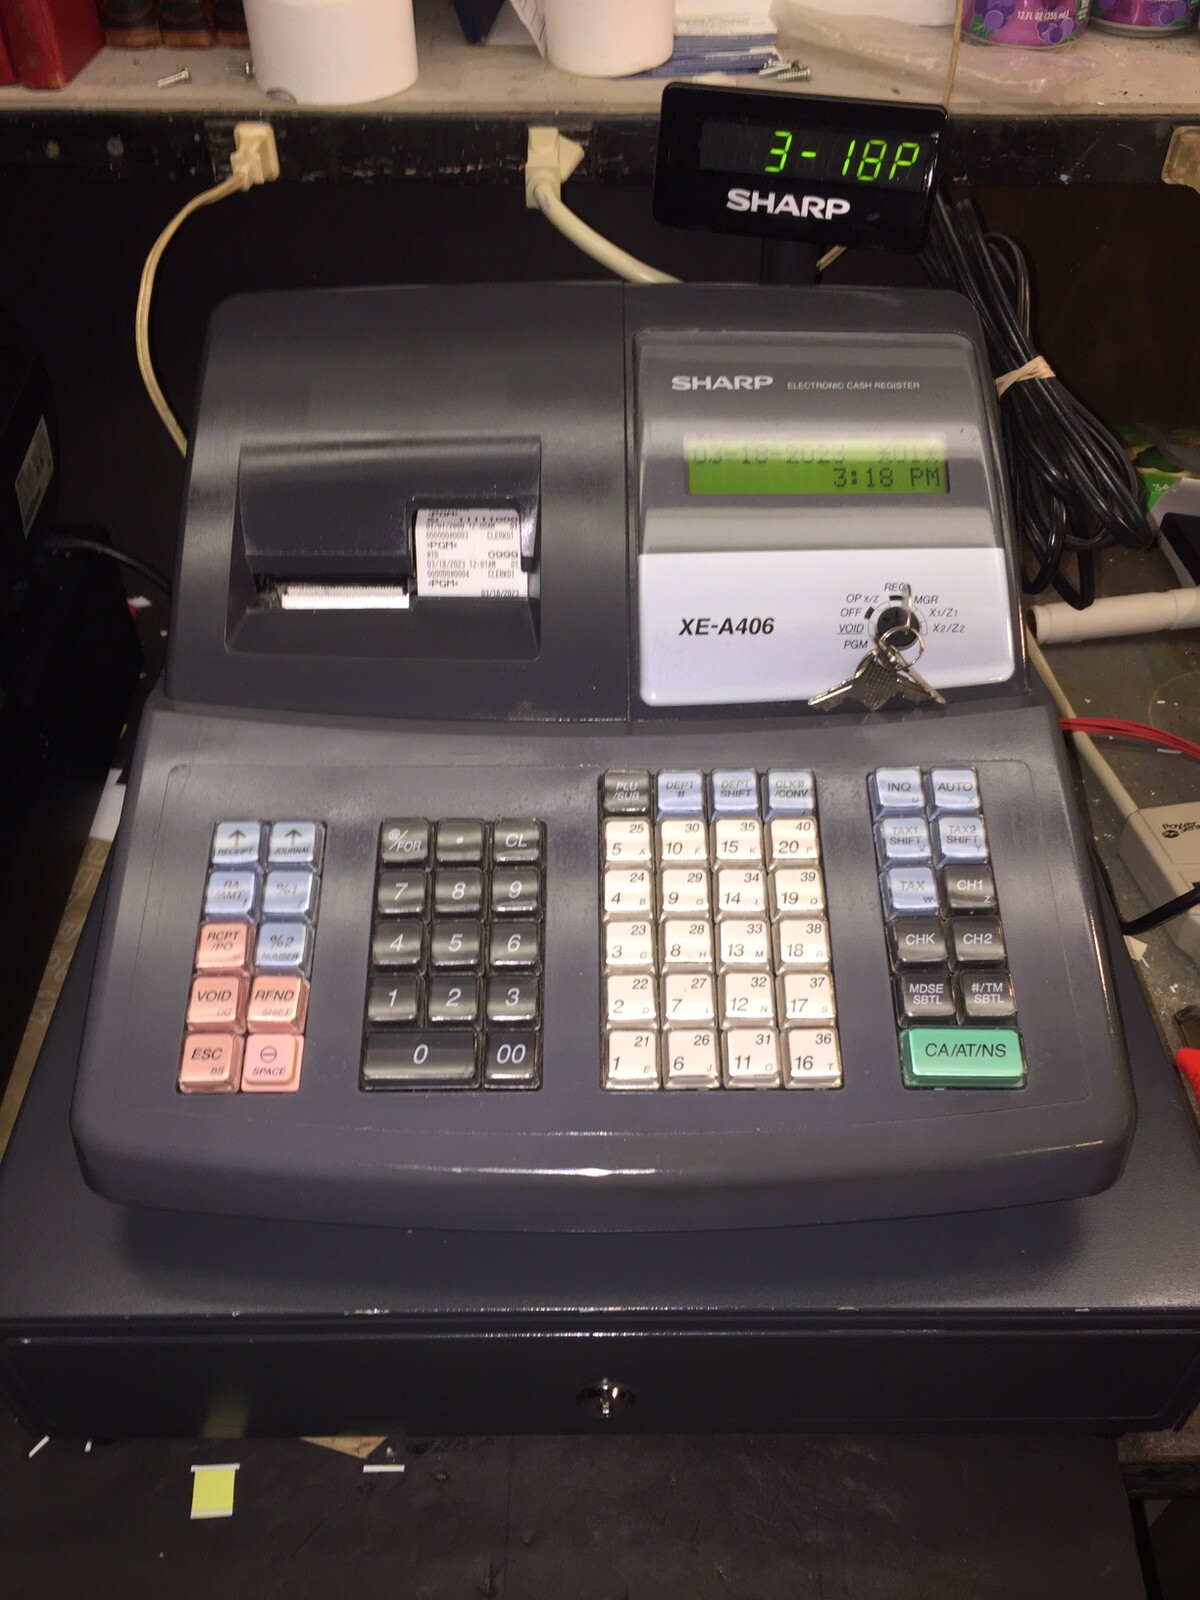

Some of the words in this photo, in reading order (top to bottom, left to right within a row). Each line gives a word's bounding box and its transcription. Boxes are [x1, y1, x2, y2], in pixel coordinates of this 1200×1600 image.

[726, 186, 851, 221] SHARP
[671, 375, 774, 392] SHARP
[787, 381, 844, 390] ELECTRONIC
[846, 381, 872, 390] CASH
[874, 381, 920, 390] REGISTER
[833, 467, 894, 488] 3:18
[910, 467, 941, 487] PM
[846, 593, 862, 604] OP
[864, 595, 880, 604] X/Z
[913, 595, 939, 605] MGR
[840, 608, 863, 618] OFF
[929, 608, 959, 618] X1/Z1
[678, 617, 775, 636] XE-A406
[838, 623, 865, 634] VOID
[932, 623, 966, 633] X2/Z2
[843, 640, 869, 650] PGM
[615, 782, 638, 790] PLU
[665, 781, 694, 790] DEPT
[720, 780, 749, 789] DEPT
[887, 782, 911, 793] INQ
[937, 782, 973, 792] AUTO
[720, 789, 752, 798] SHIFT
[774, 789, 809, 798] /CONV
[629, 823, 644, 834] 25
[685, 823, 700, 833] 30
[740, 822, 755, 832] 35
[795, 822, 811, 832] 40
[891, 826, 918, 834] TAX1
[948, 825, 977, 834] TAX2
[504, 833, 528, 848] CL
[889, 836, 922, 845] SHIFT
[946, 835, 979, 844] SHIFT
[272, 847, 311, 855] JOURNAL
[611, 842, 622, 855] 5
[665, 842, 683, 855] 10
[721, 841, 739, 854] 15
[777, 841, 800, 854] 20
[629, 873, 645, 883] 24
[687, 873, 703, 883] 29
[744, 873, 760, 883] 34
[800, 872, 816, 882] 39
[508, 880, 522, 898] 9
[900, 880, 925, 891] TAX
[956, 879, 984, 890] CH1
[394, 882, 409, 900] 7
[451, 881, 466, 900] 8
[611, 892, 622, 904] 4
[668, 892, 679, 904] 9
[724, 892, 742, 904] 14
[781, 892, 799, 904] 19
[631, 924, 646, 935] 23
[689, 924, 705, 935] 28
[746, 923, 763, 934] 33
[806, 923, 822, 934] 38
[389, 933, 404, 952] 4
[448, 933, 463, 952] 5
[507, 933, 521, 952] 6
[905, 933, 935, 945] CHK
[962, 933, 992, 944] CH2
[611, 945, 622, 958] 3
[670, 944, 681, 958] 8
[727, 944, 744, 957] 13
[786, 944, 804, 957] 18
[632, 978, 649, 989] 22
[690, 978, 708, 989] 27
[750, 977, 767, 988] 32
[809, 977, 826, 988] 37
[971, 982, 1004, 993] #/TM
[909, 983, 944, 994] MDSE
[197, 989, 232, 1002] VOID
[254, 989, 294, 1001] RFND
[388, 988, 398, 1008] 1
[445, 987, 462, 1007] 2
[504, 987, 520, 1007] 3
[913, 996, 943, 1005] SBTL
[974, 994, 1005, 1004] SBTL
[612, 1000, 625, 1014] 2
[671, 998, 683, 1012] 7
[730, 997, 749, 1012] 12
[790, 998, 809, 1012] 17
[633, 1035, 650, 1047] 21
[693, 1034, 710, 1046] 26
[755, 1034, 771, 1045] 31
[815, 1033, 832, 1045] 36
[191, 1047, 223, 1061] ESC
[413, 1044, 428, 1064] 0
[496, 1043, 526, 1064] 00
[924, 1042, 1007, 1058] CA/AT/NS
[612, 1056, 621, 1070] 1
[673, 1056, 685, 1071] 6
[734, 1055, 751, 1070] 11
[794, 1056, 814, 1070] 16
[252, 1066, 288, 1076] SPACE
